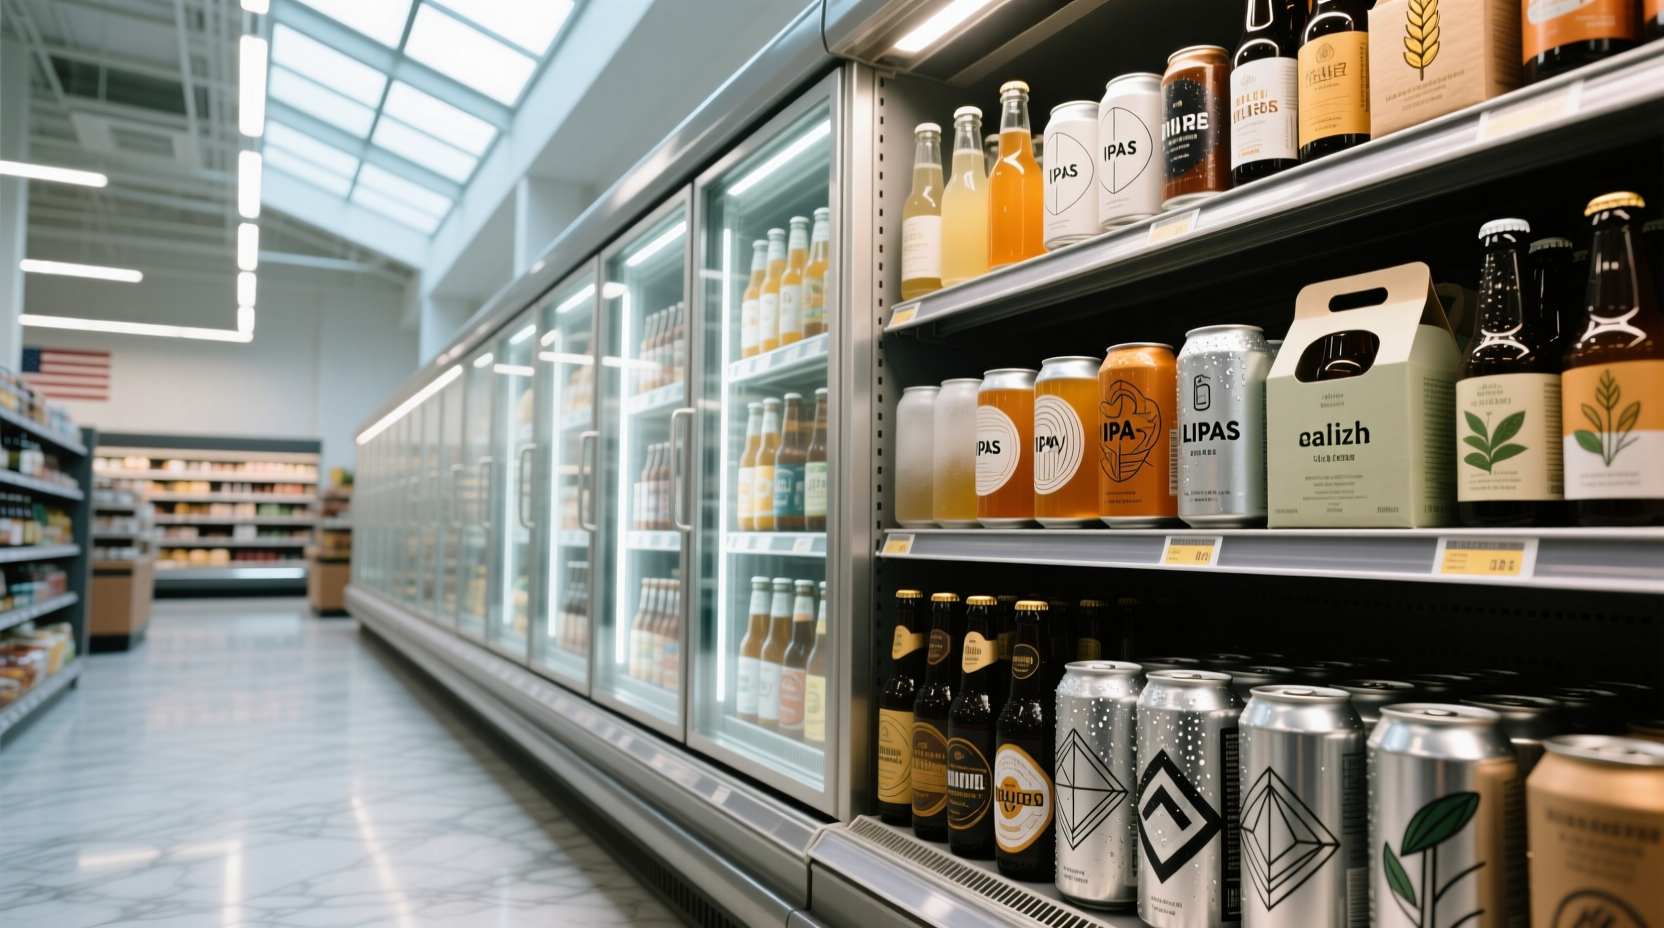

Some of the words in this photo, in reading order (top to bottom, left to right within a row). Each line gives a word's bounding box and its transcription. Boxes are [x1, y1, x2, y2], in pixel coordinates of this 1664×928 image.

[1104, 140, 1137, 162] IPAS
[1049, 164, 1078, 185] IPAS
[1103, 420, 1136, 442] IPA
[1183, 420, 1240, 443] LIPAS
[1299, 420, 1370, 448] ealizh
